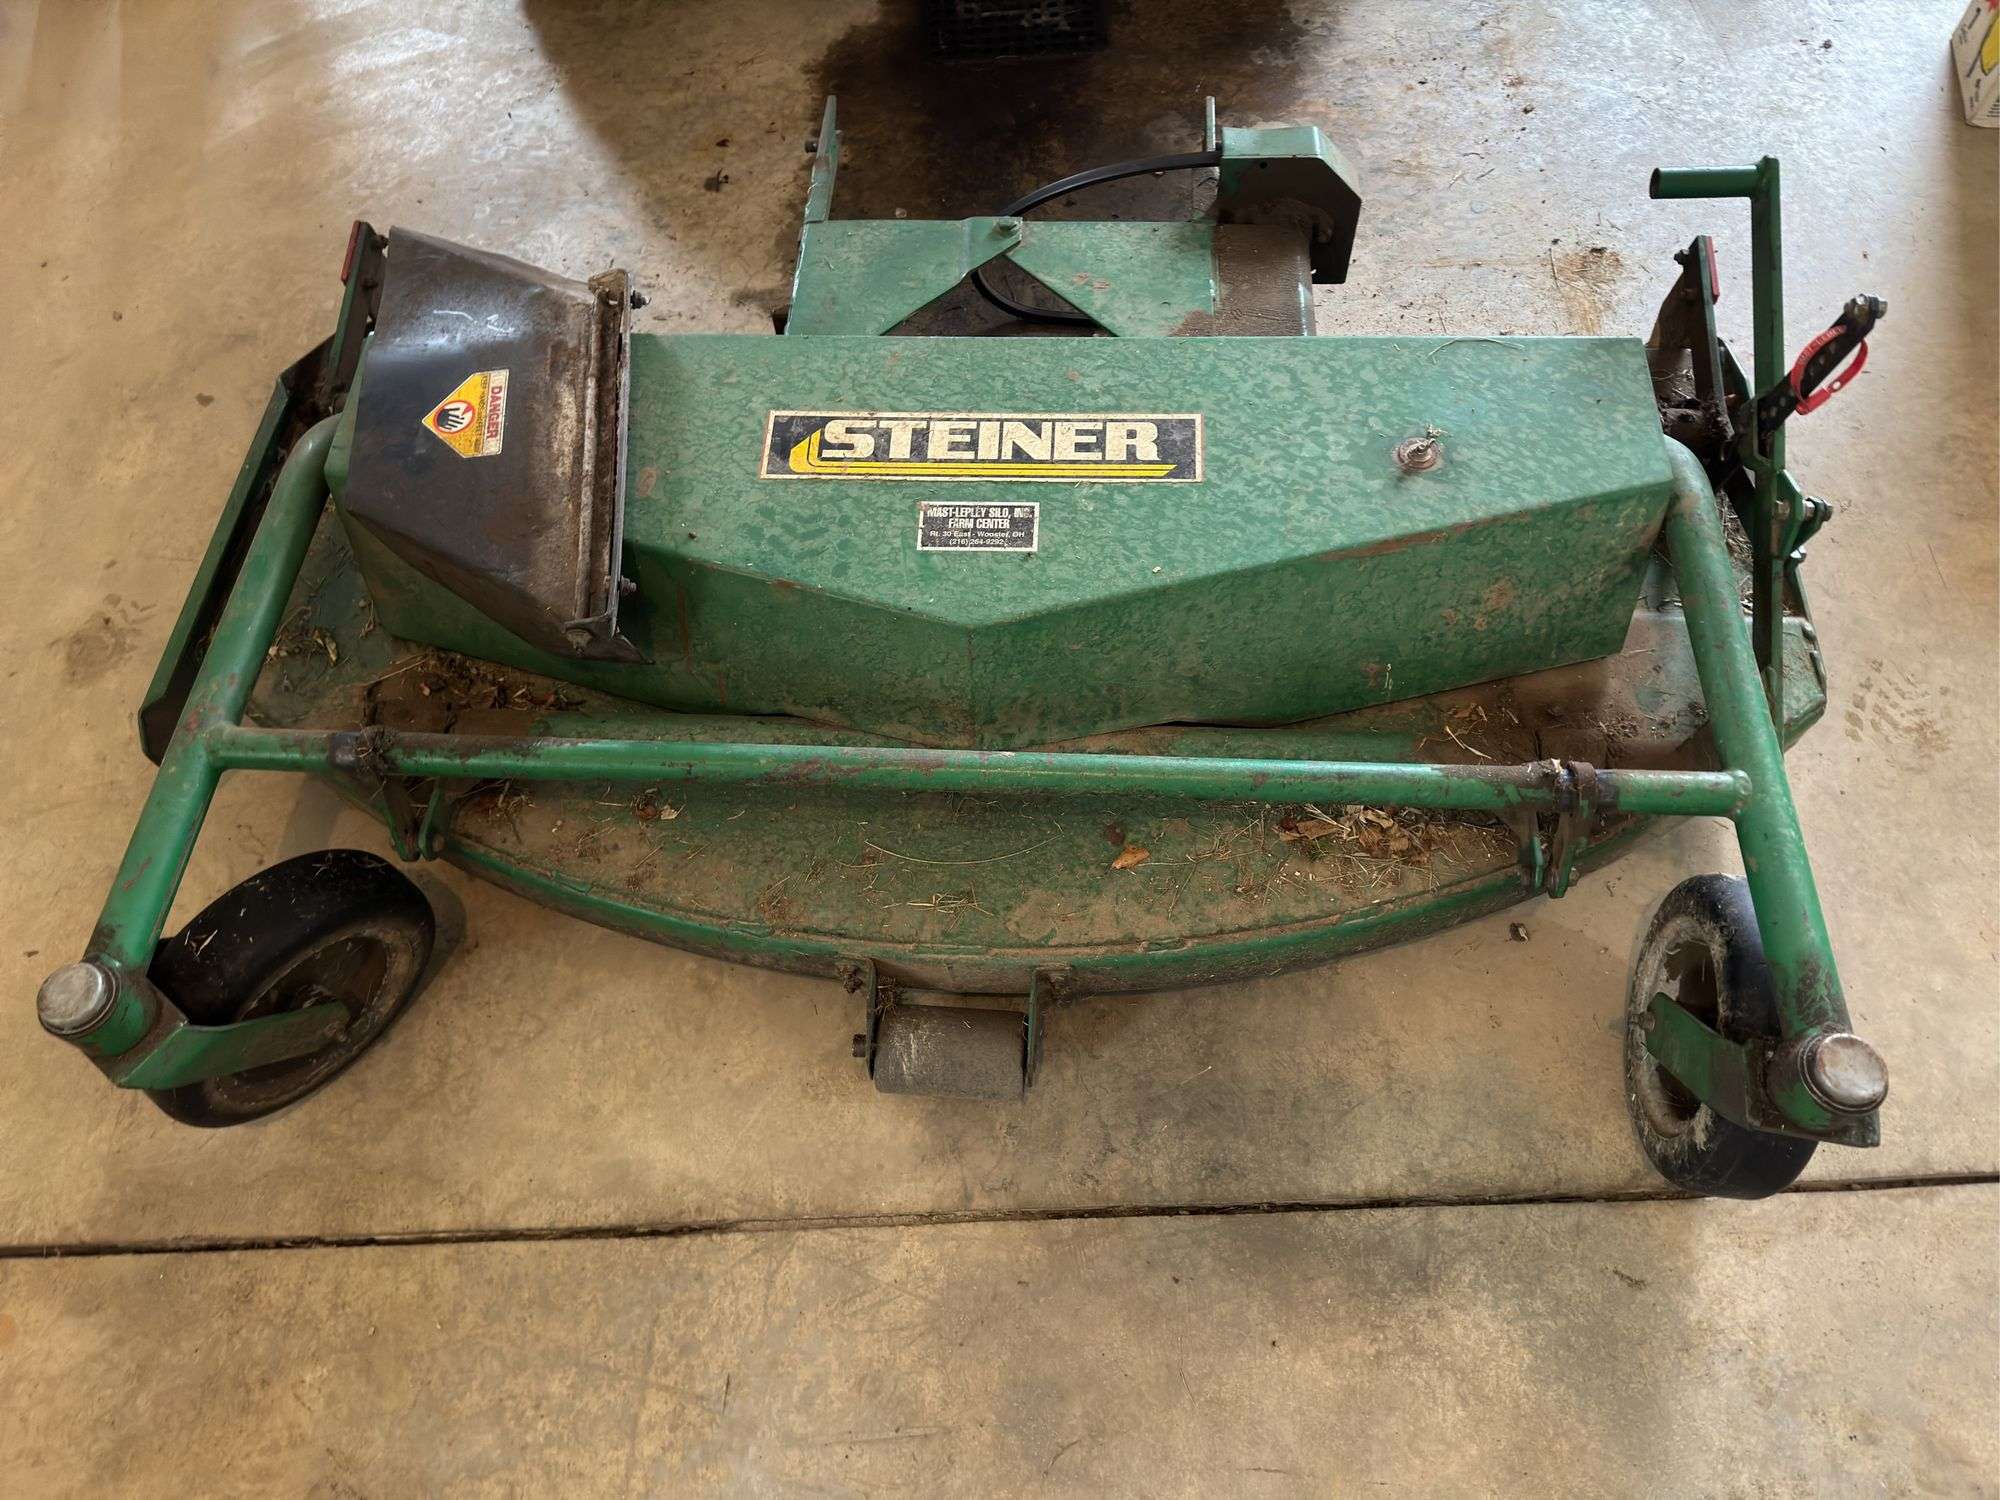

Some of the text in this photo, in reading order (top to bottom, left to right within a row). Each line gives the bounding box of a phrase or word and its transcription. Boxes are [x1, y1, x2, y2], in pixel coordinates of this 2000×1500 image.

[487, 385, 502, 440] DANGER
[821, 419, 1160, 461] STEINER
[927, 506, 986, 518] MAST-LEPLEY
[948, 518, 1011, 529] FARM CENTER
